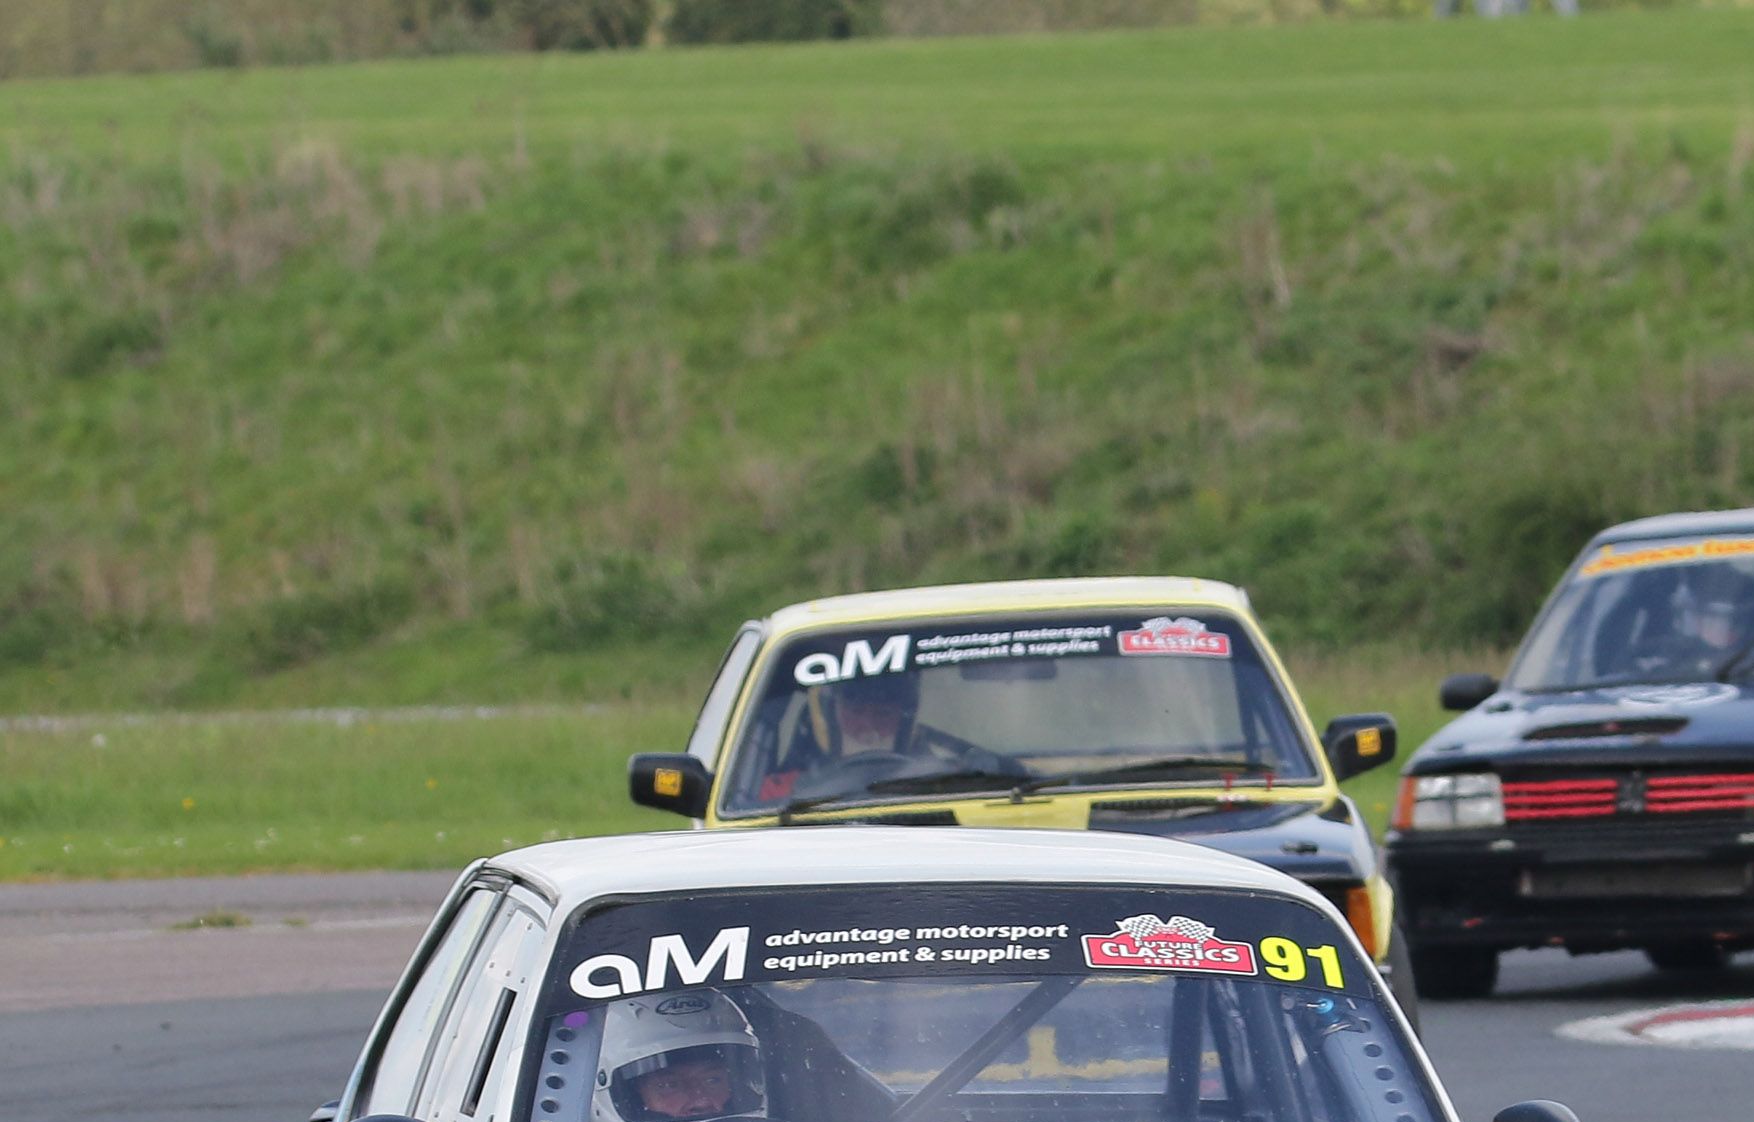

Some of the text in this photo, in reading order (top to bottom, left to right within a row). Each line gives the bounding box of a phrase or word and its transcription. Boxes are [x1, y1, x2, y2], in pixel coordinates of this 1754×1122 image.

[916, 625, 1111, 650] advantage motorsport
[794, 635, 910, 686] aM
[915, 643, 1008, 664] equipment
[1028, 638, 1099, 656] supplies
[765, 923, 1070, 948] advantage motorsport
[1135, 940, 1202, 950] FUTURE
[570, 926, 750, 999] aM
[763, 944, 1051, 972] equipment & supplies
[1101, 942, 1240, 963] CLASSICS
[1143, 957, 1201, 966] SERIES
[1260, 936, 1345, 989] 91
